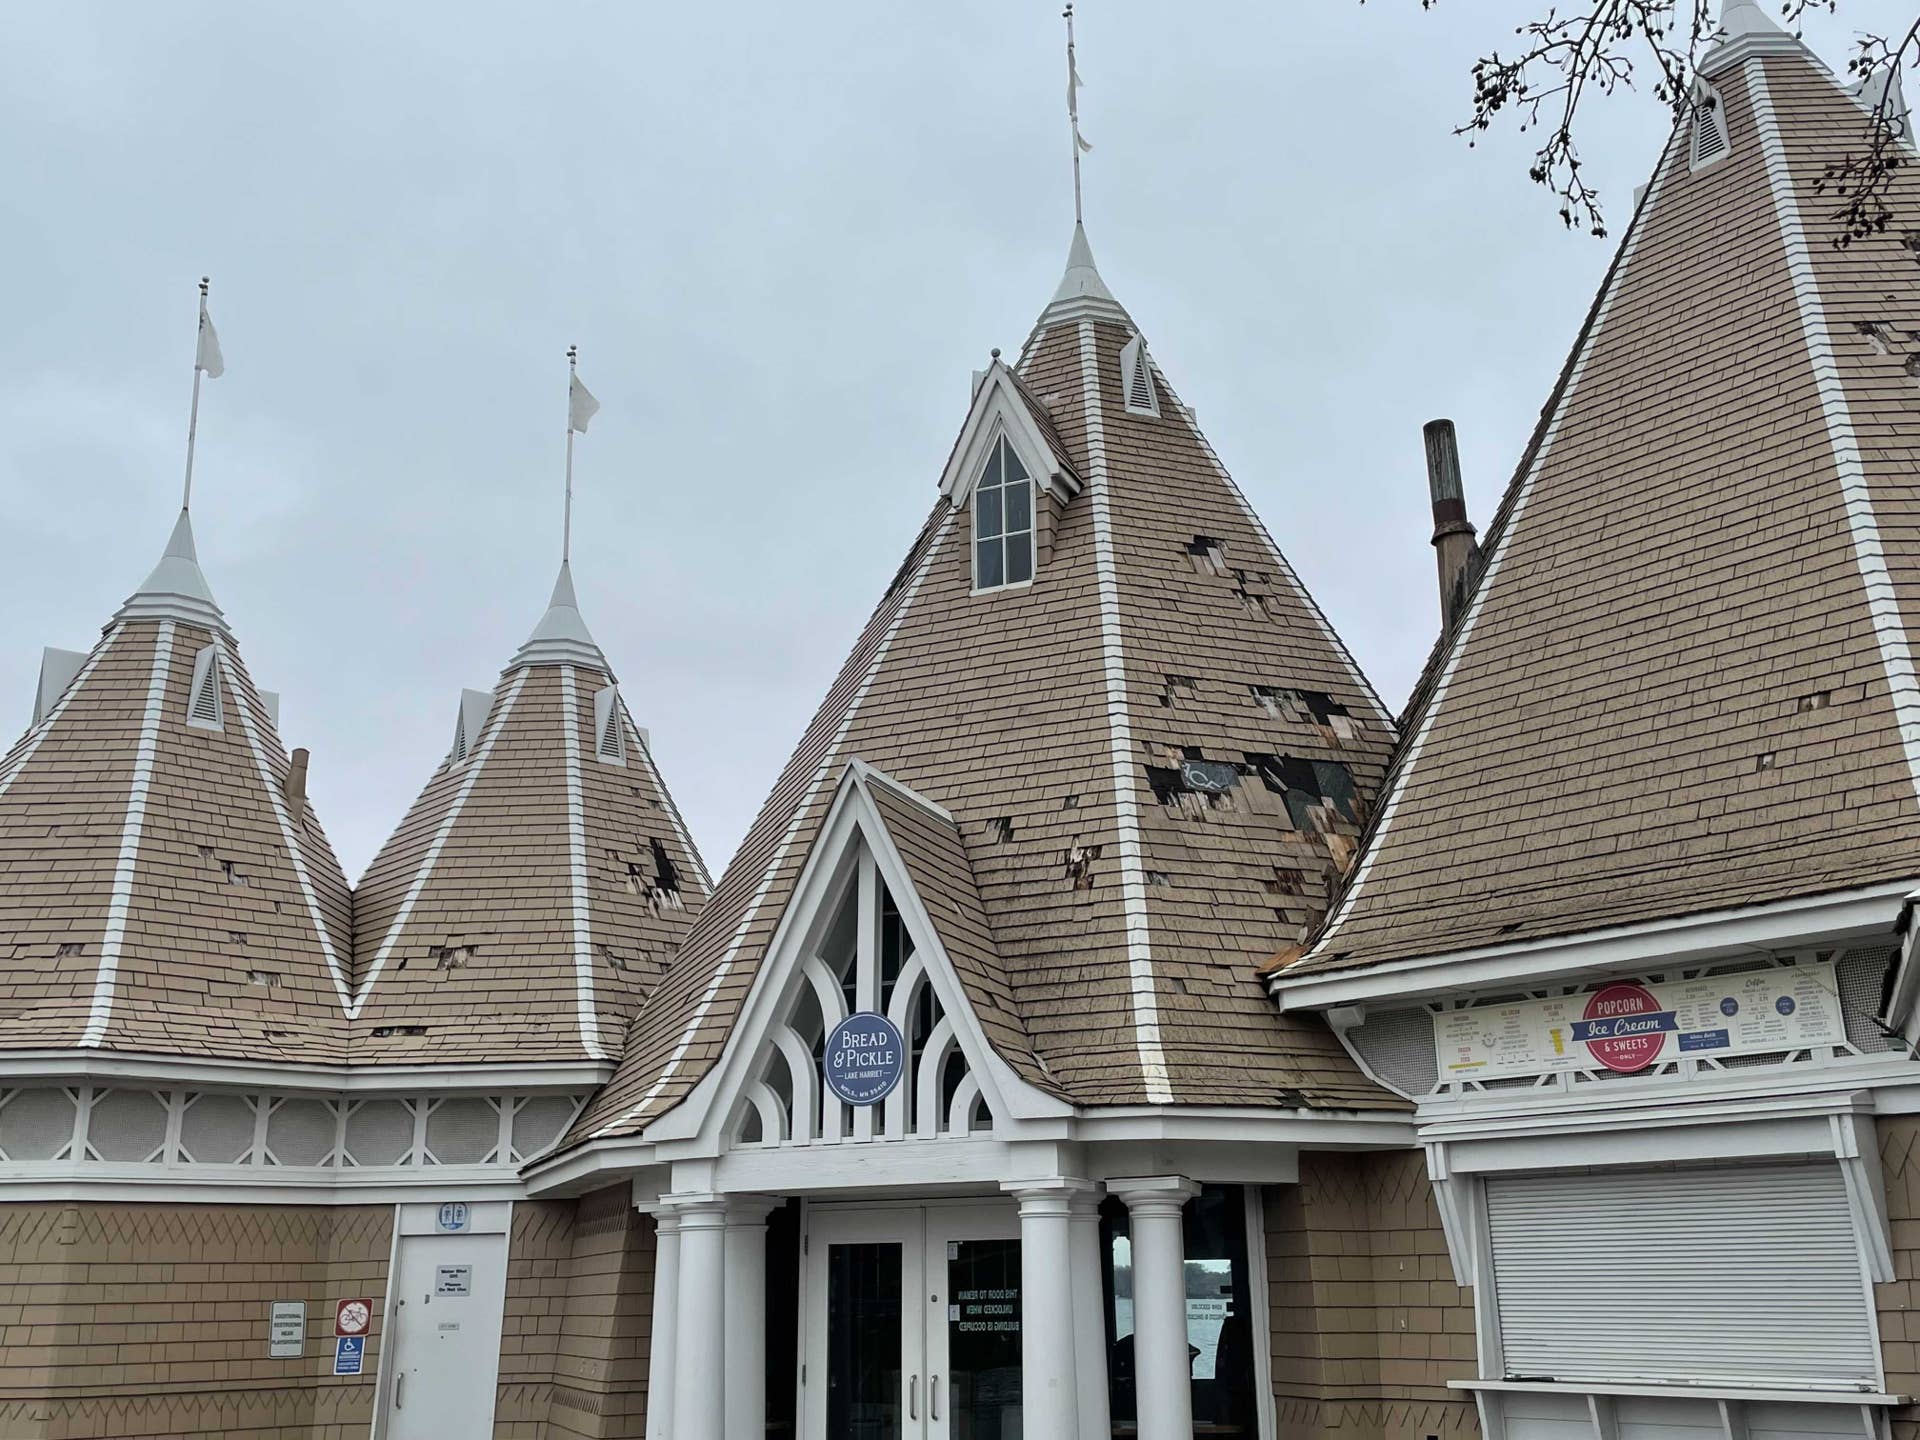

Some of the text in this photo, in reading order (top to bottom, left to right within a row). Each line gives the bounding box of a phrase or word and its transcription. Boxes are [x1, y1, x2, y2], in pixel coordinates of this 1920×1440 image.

[1597, 997, 1643, 1015] POPCORN
[1588, 1018, 1661, 1036] Ice Cream
[842, 1031, 887, 1048] BREAD
[1604, 1038, 1649, 1052] & SWEETS
[833, 1049, 894, 1068] & PICKLE
[844, 1069, 883, 1080] LAKE HARRIET
